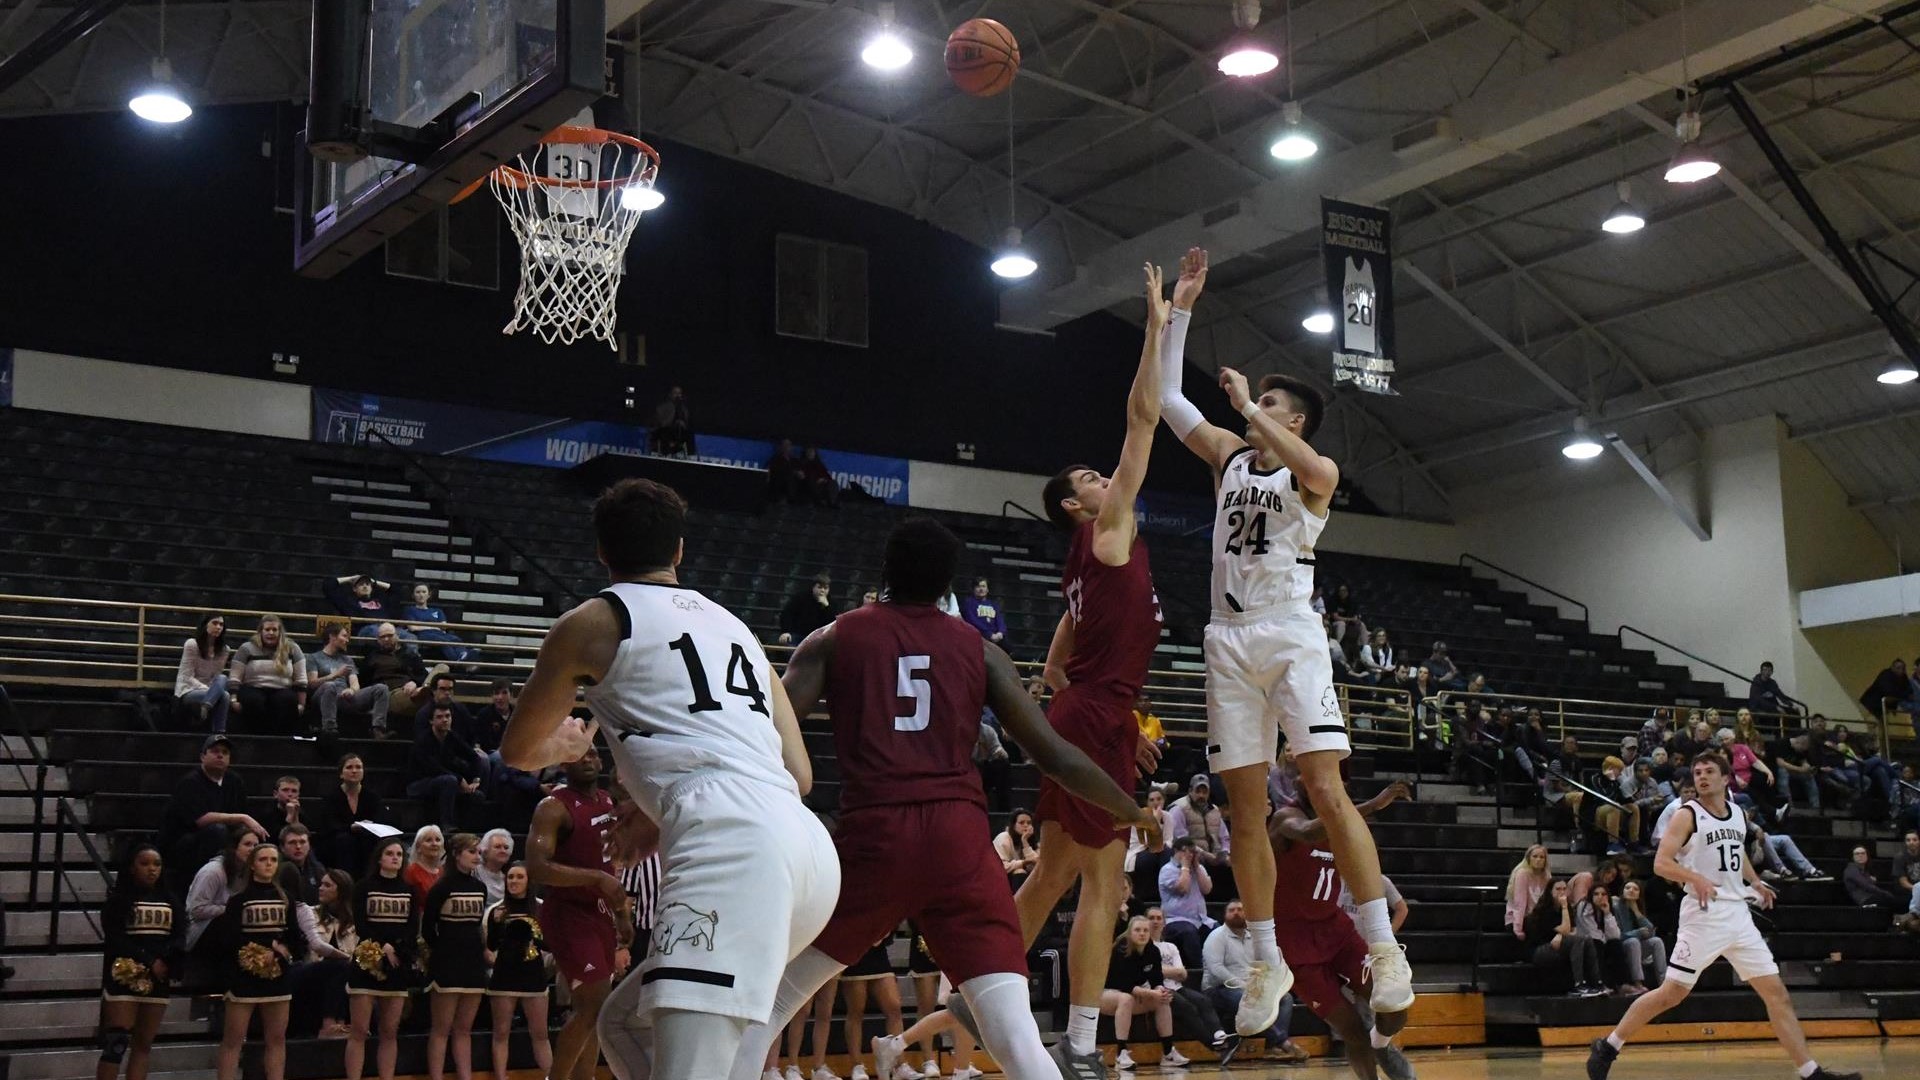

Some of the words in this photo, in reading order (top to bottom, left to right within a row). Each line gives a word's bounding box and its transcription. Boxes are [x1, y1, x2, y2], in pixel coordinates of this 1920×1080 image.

[555, 154, 593, 182] 30
[1327, 211, 1384, 237] BISON
[1348, 303, 1372, 327] 20
[359, 421, 425, 439] BASKETBALL
[1224, 510, 1271, 556] 24
[668, 632, 770, 715] 14
[894, 654, 932, 732] 5
[1717, 844, 1740, 872] 15
[1312, 866, 1336, 901] 11
